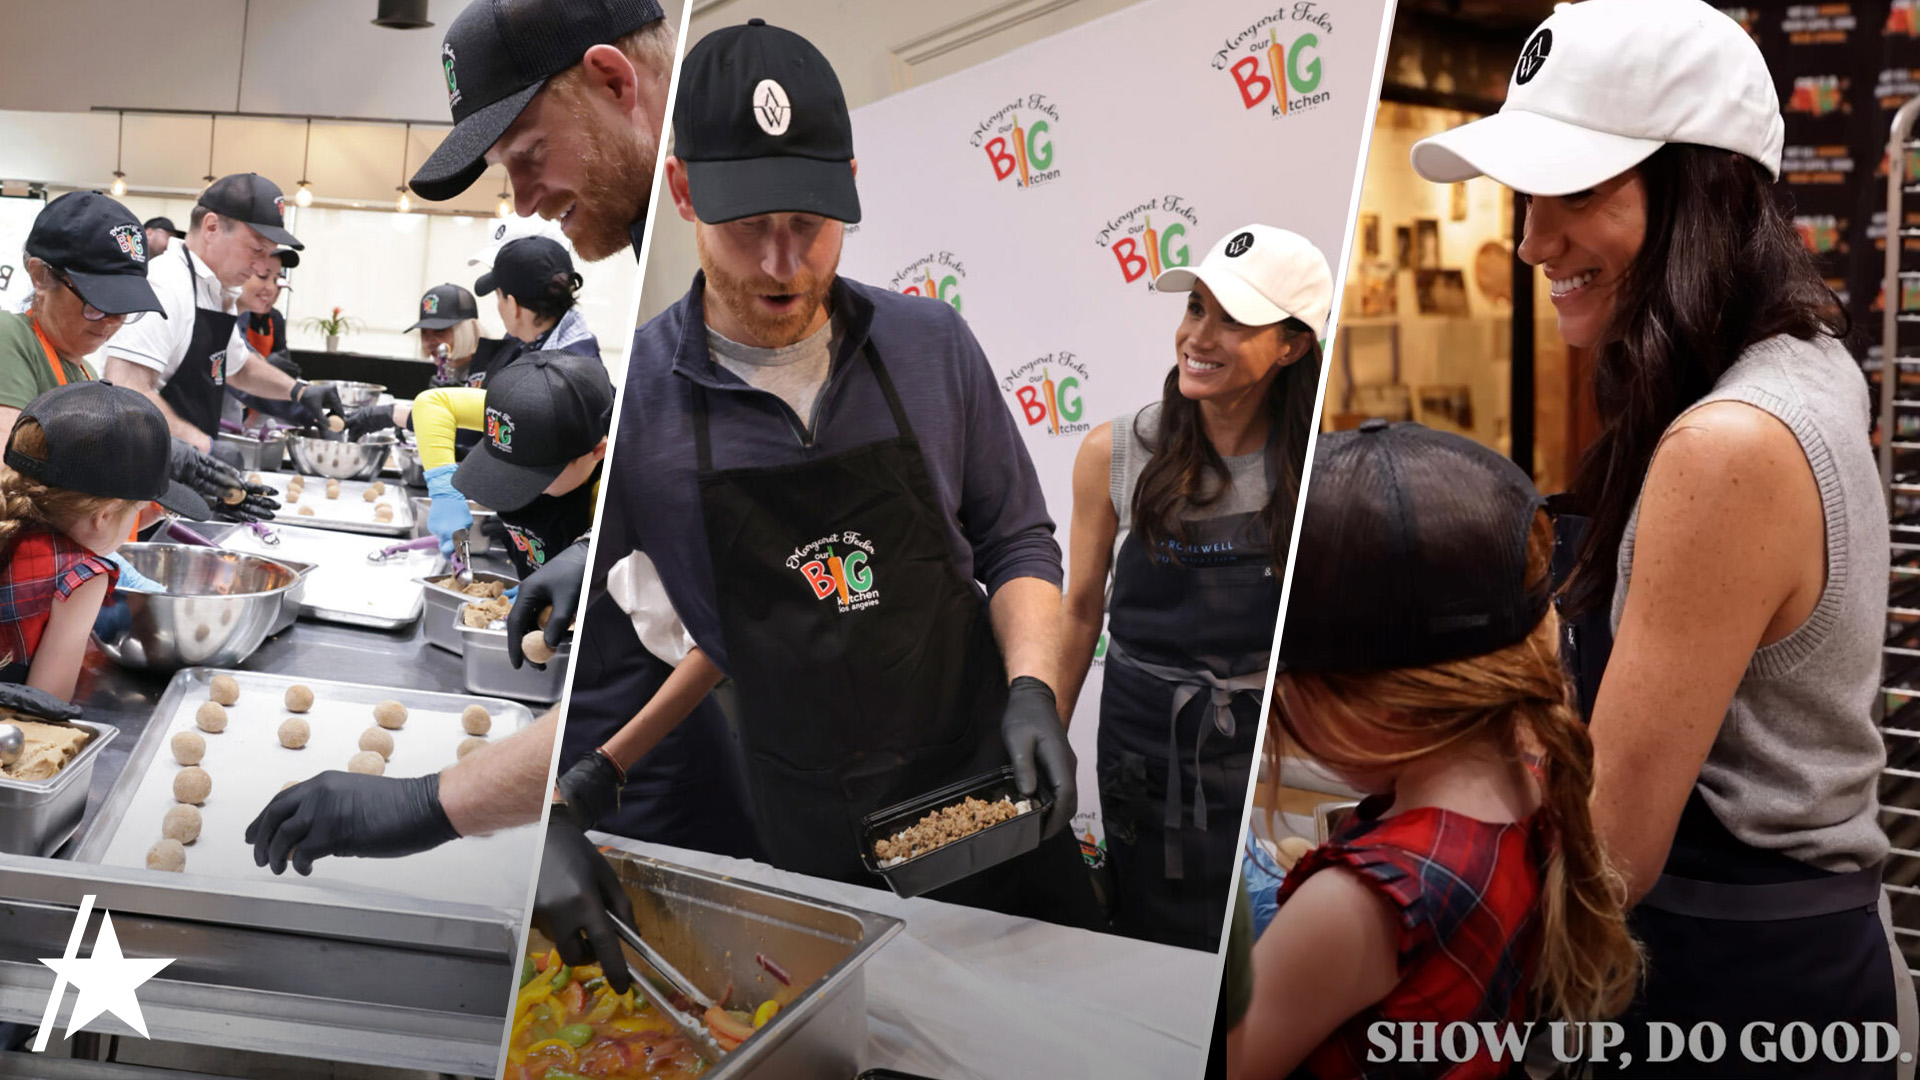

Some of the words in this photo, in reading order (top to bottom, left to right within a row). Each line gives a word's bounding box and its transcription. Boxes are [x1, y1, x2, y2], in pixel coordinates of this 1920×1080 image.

[1211, 7, 1285, 70] Margaret
[1291, 1, 1333, 34] Feder
[1250, 39, 1270, 52] our
[970, 97, 1023, 148] Margaret
[1027, 93, 1059, 123] Feder
[998, 123, 1013, 133] our
[1095, 198, 1158, 247] Margaret
[1162, 195, 1198, 226] Feder
[1128, 225, 1144, 234] our
[1001, 353, 1054, 392] Margaret
[1058, 351, 1089, 380] Feder
[1029, 375, 1043, 383] our
[785, 533, 840, 570] Margaret
[842, 530, 875, 555] Feder
[814, 552, 830, 560] our
